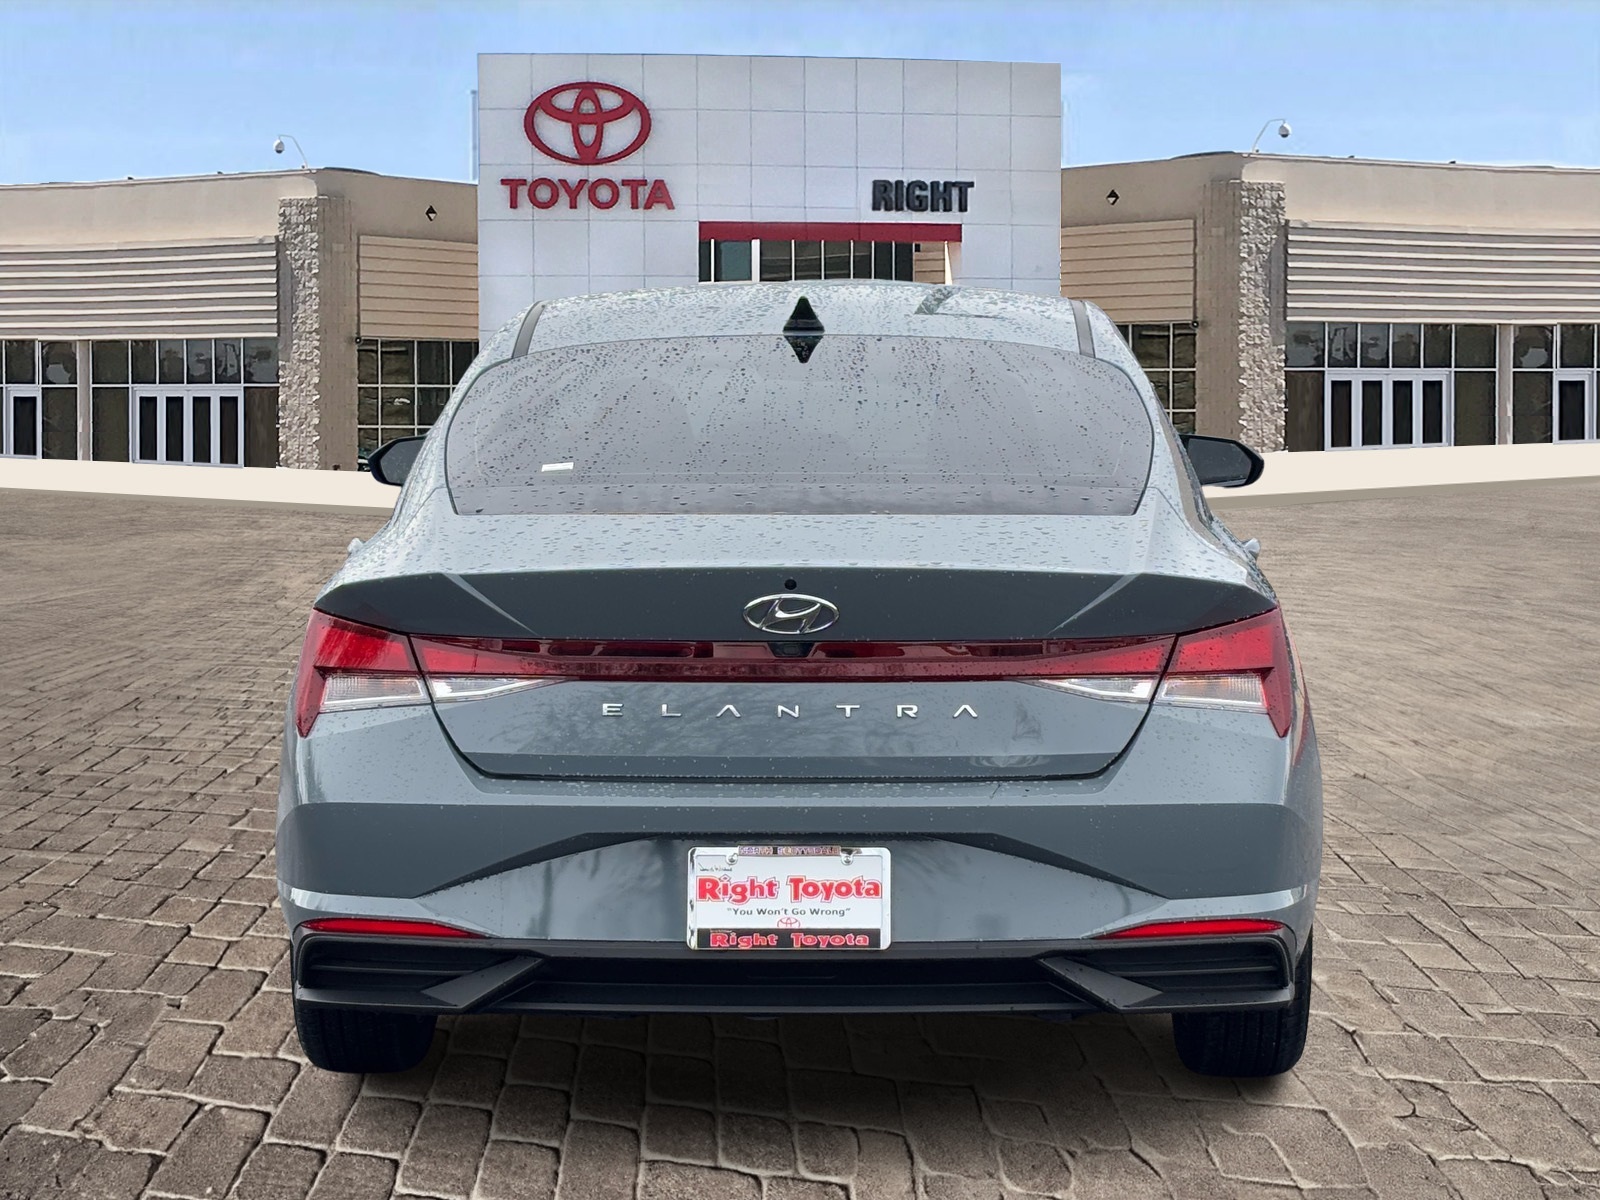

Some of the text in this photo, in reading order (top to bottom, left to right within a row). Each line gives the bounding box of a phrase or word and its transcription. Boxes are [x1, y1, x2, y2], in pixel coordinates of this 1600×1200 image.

[500, 178, 675, 210] TOYOTA
[872, 179, 975, 213] RIGHT
[602, 702, 978, 718] ELANTRA
[696, 875, 883, 905] Right Toyota
[756, 907, 788, 916] Won't
[791, 907, 806, 916] Go
[710, 932, 869, 949] Right Toyota
